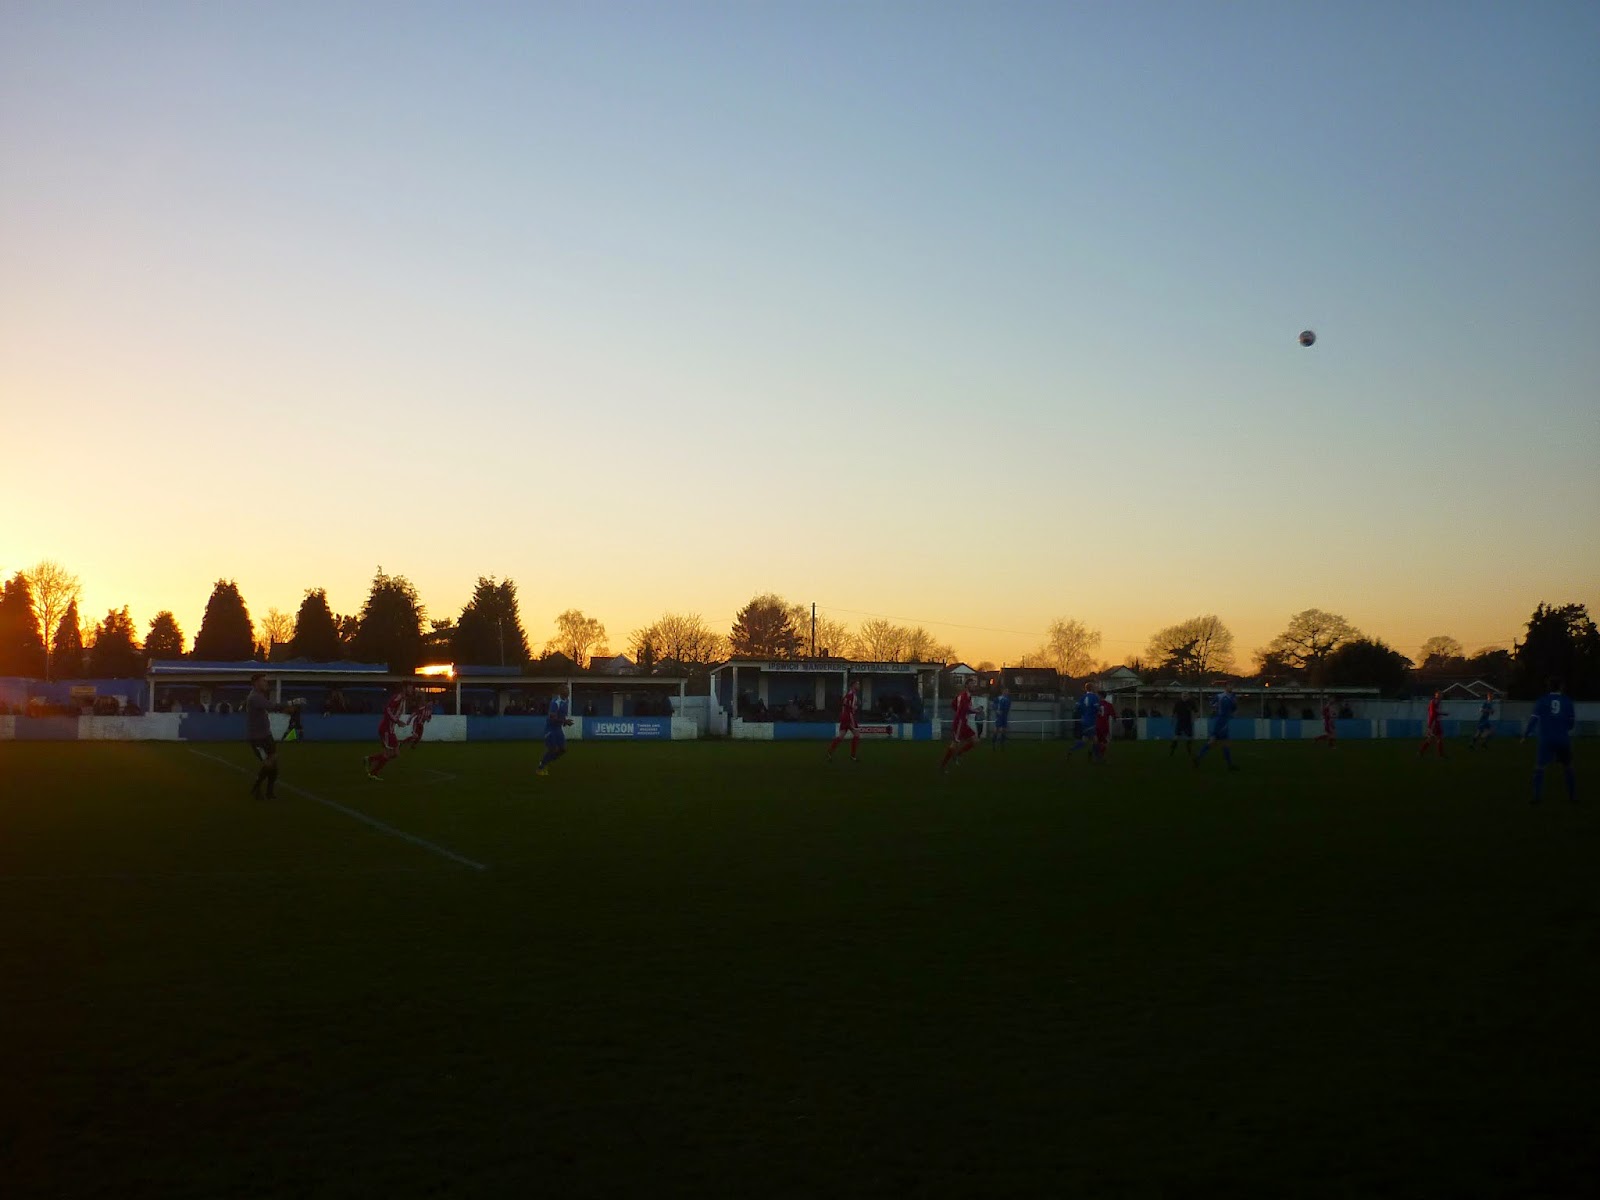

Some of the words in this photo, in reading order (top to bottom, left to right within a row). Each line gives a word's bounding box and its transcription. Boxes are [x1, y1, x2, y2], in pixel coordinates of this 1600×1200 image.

[768, 662, 799, 671] IPSWICH
[802, 663, 847, 671] WANDERERS
[850, 663, 889, 672] FOOTBALL
[892, 664, 910, 673] CLUB
[1550, 699, 1561, 715] 9
[595, 722, 634, 733] JEWSON
